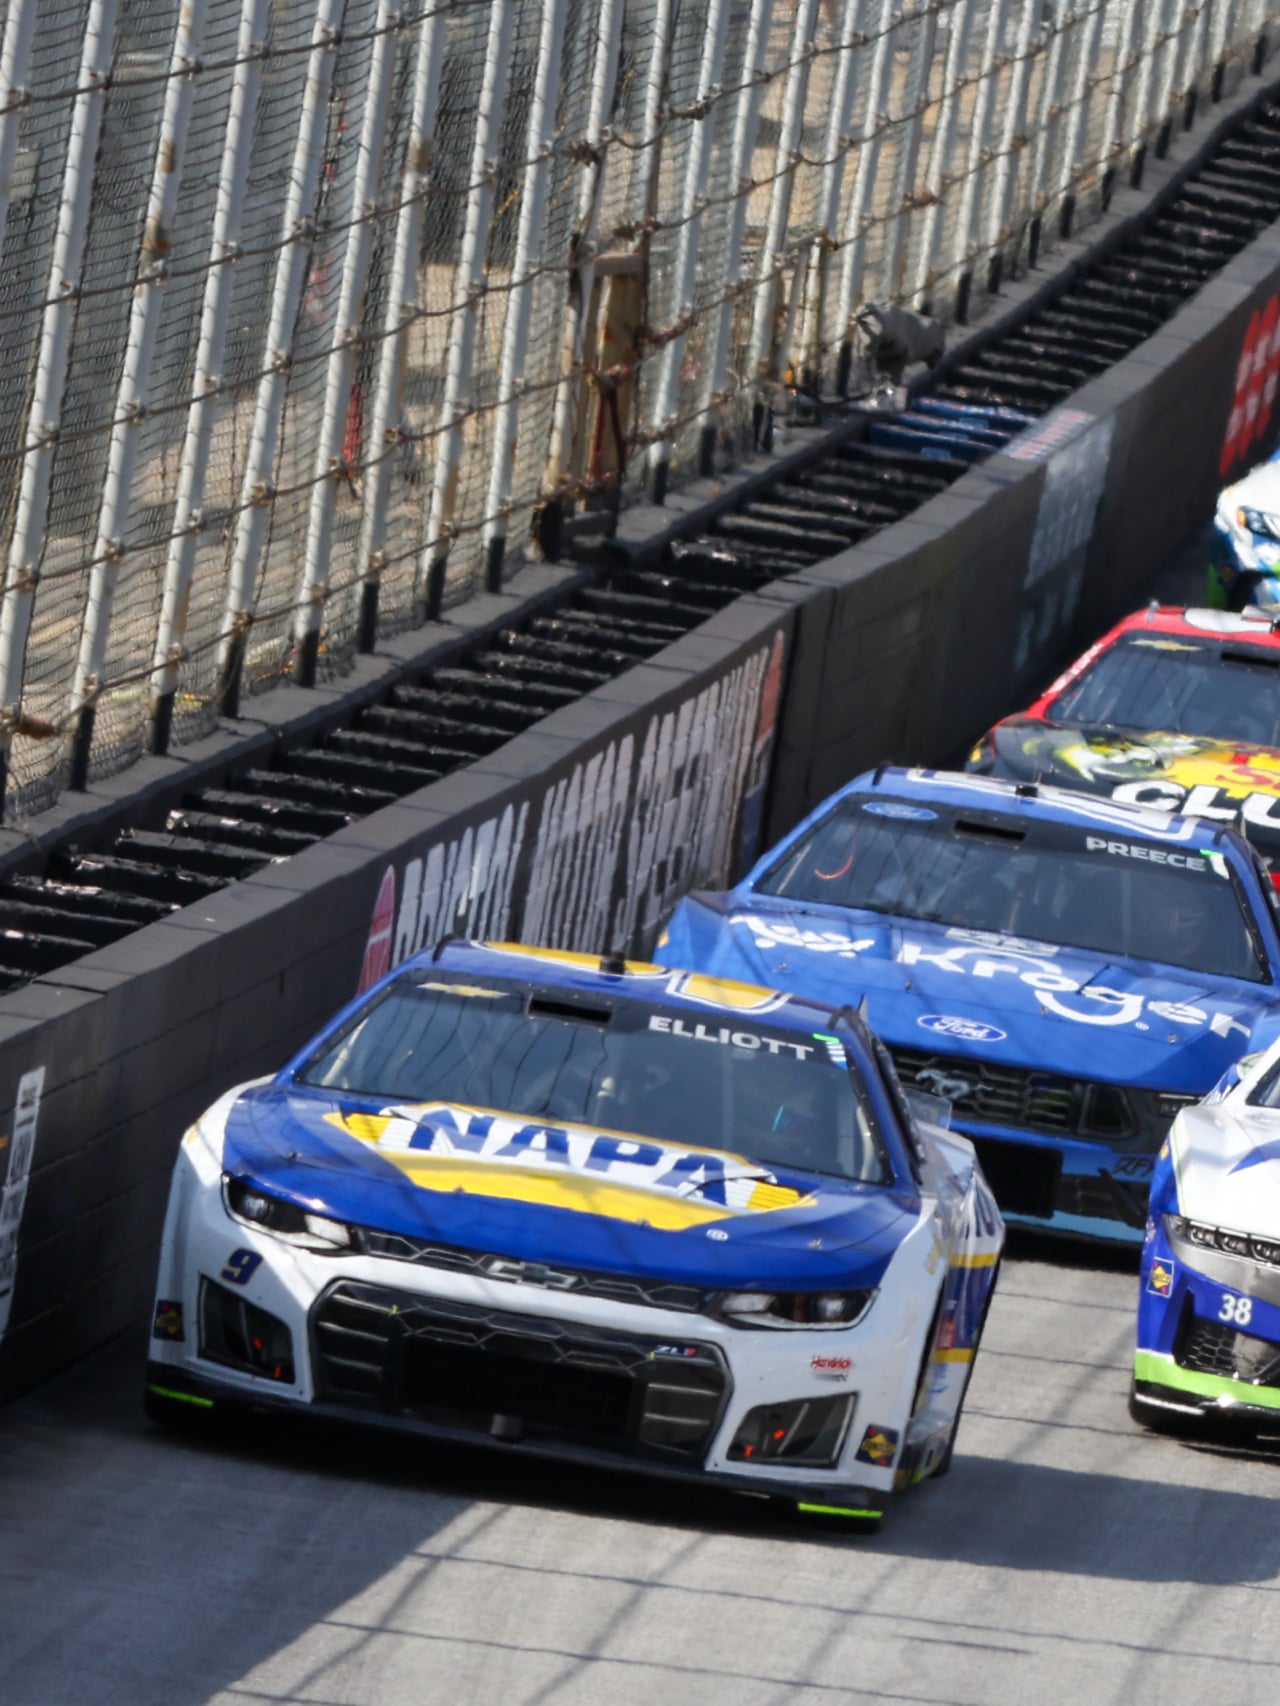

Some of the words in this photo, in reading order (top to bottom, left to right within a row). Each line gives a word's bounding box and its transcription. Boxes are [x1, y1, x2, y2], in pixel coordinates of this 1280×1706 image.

[521, 733, 635, 953] MOTOR
[1086, 838, 1206, 871] PREECE
[896, 943, 1252, 1039] Kroger
[649, 1015, 814, 1061] ELLIOTT
[408, 1107, 728, 1206] NAPA
[221, 1247, 263, 1286] 9
[1218, 1292, 1253, 1327] 38
